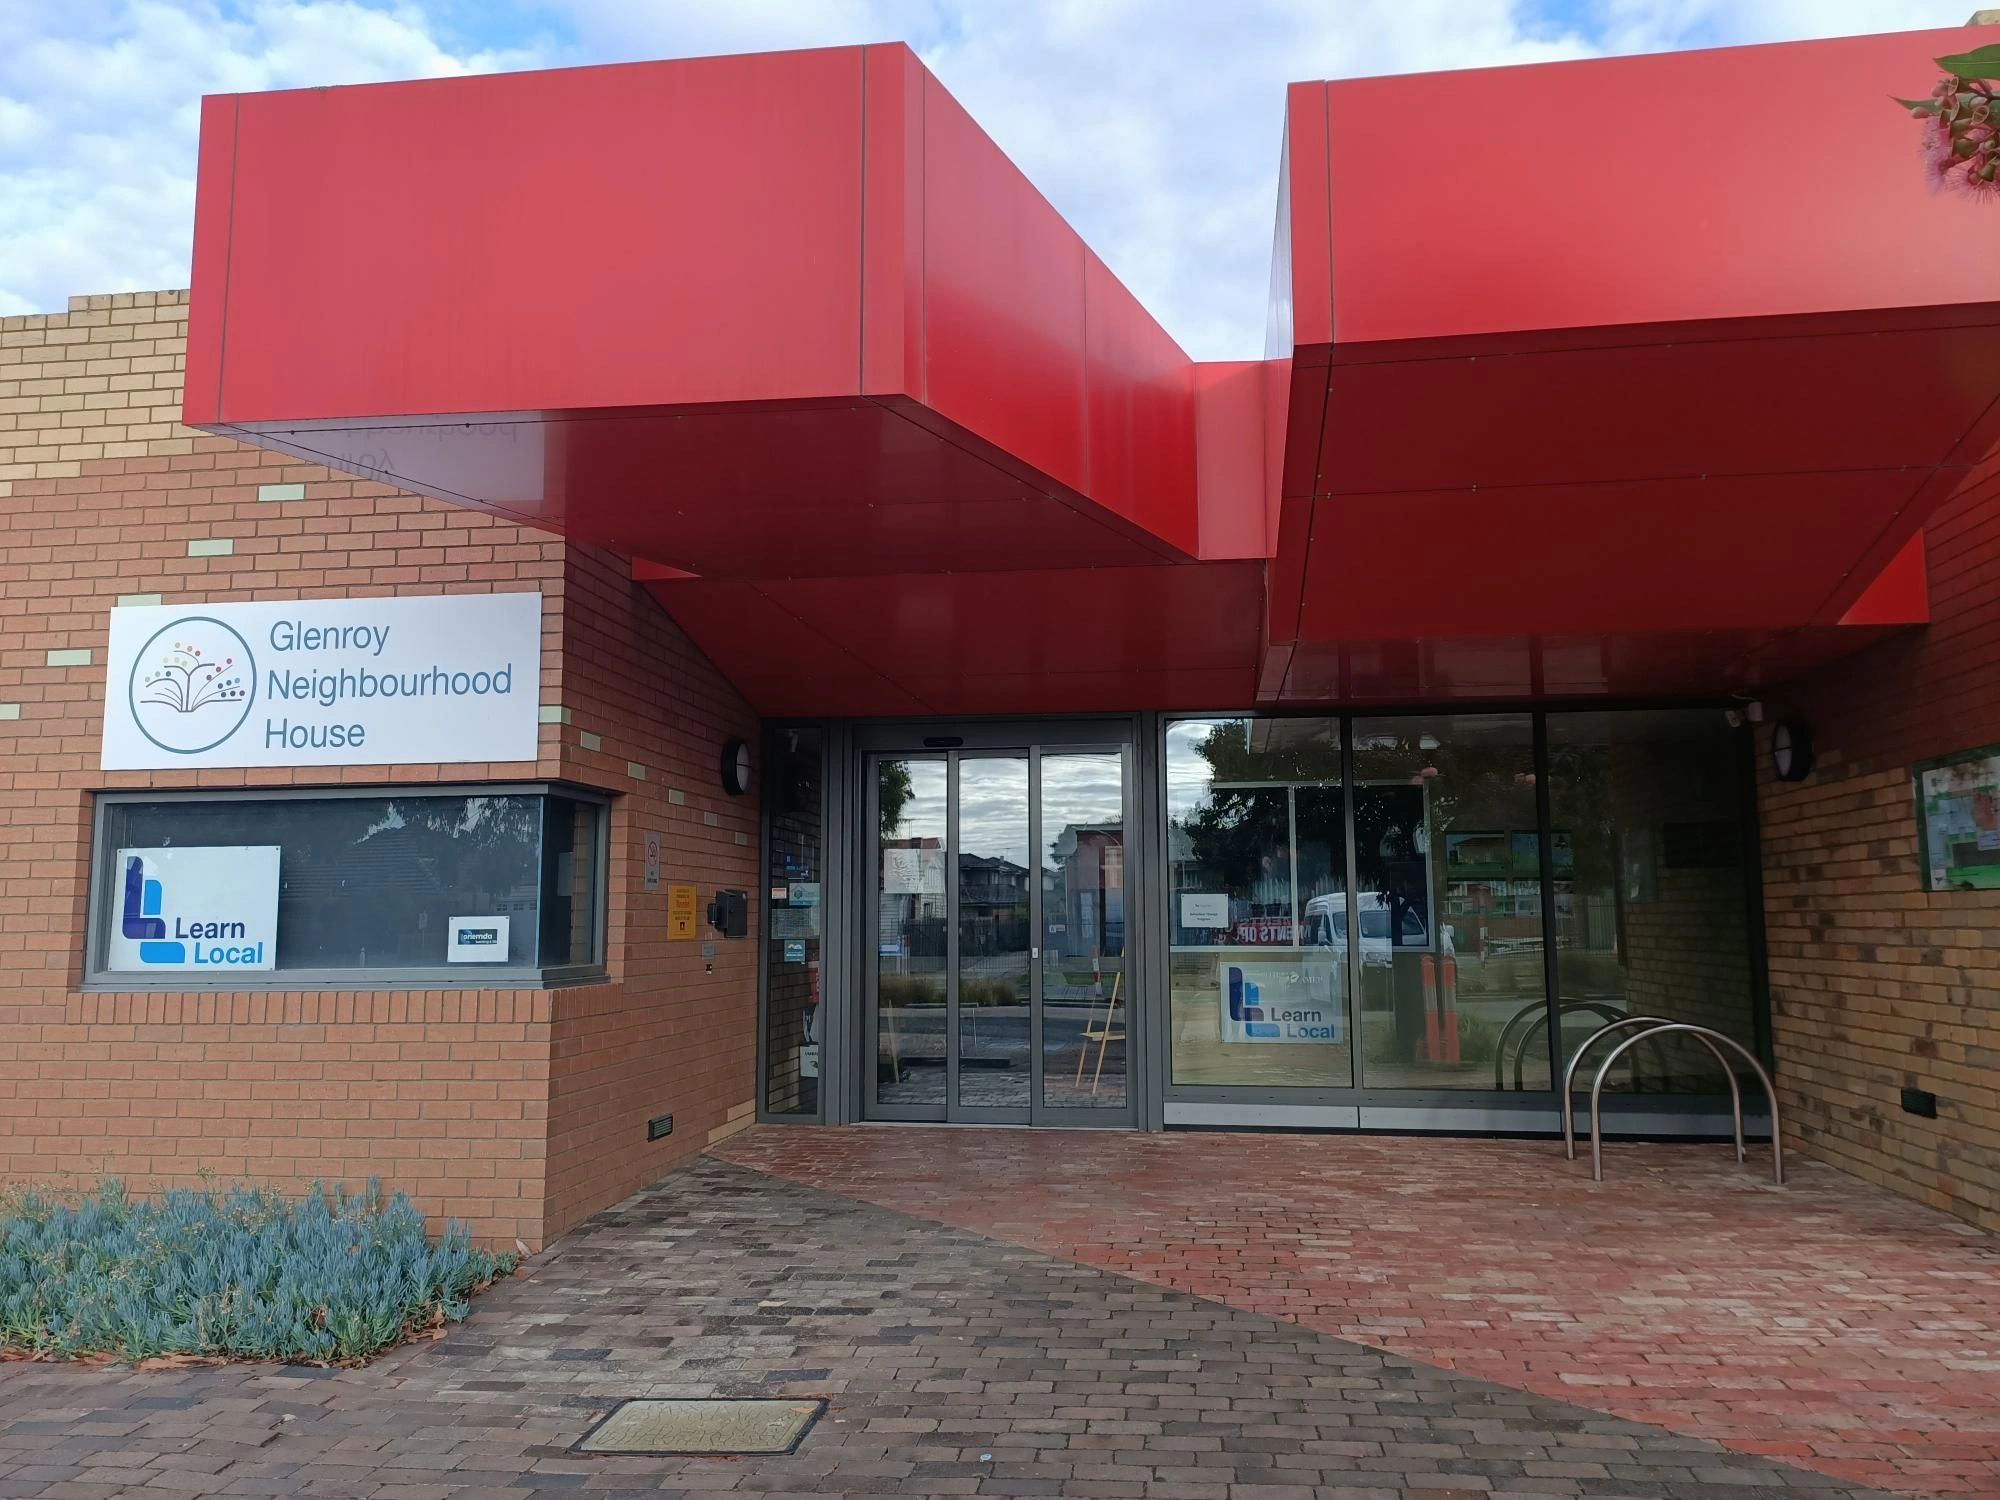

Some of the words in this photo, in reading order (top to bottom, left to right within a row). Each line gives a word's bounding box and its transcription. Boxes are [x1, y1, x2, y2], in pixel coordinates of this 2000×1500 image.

[270, 620, 390, 656] Glenroy
[268, 663, 512, 707] Neighbourhood
[265, 718, 365, 749] House
[175, 917, 245, 939] Learn
[194, 942, 263, 964] Local
[1271, 1007, 1322, 1022] Learn
[1287, 1024, 1335, 1039] Local
